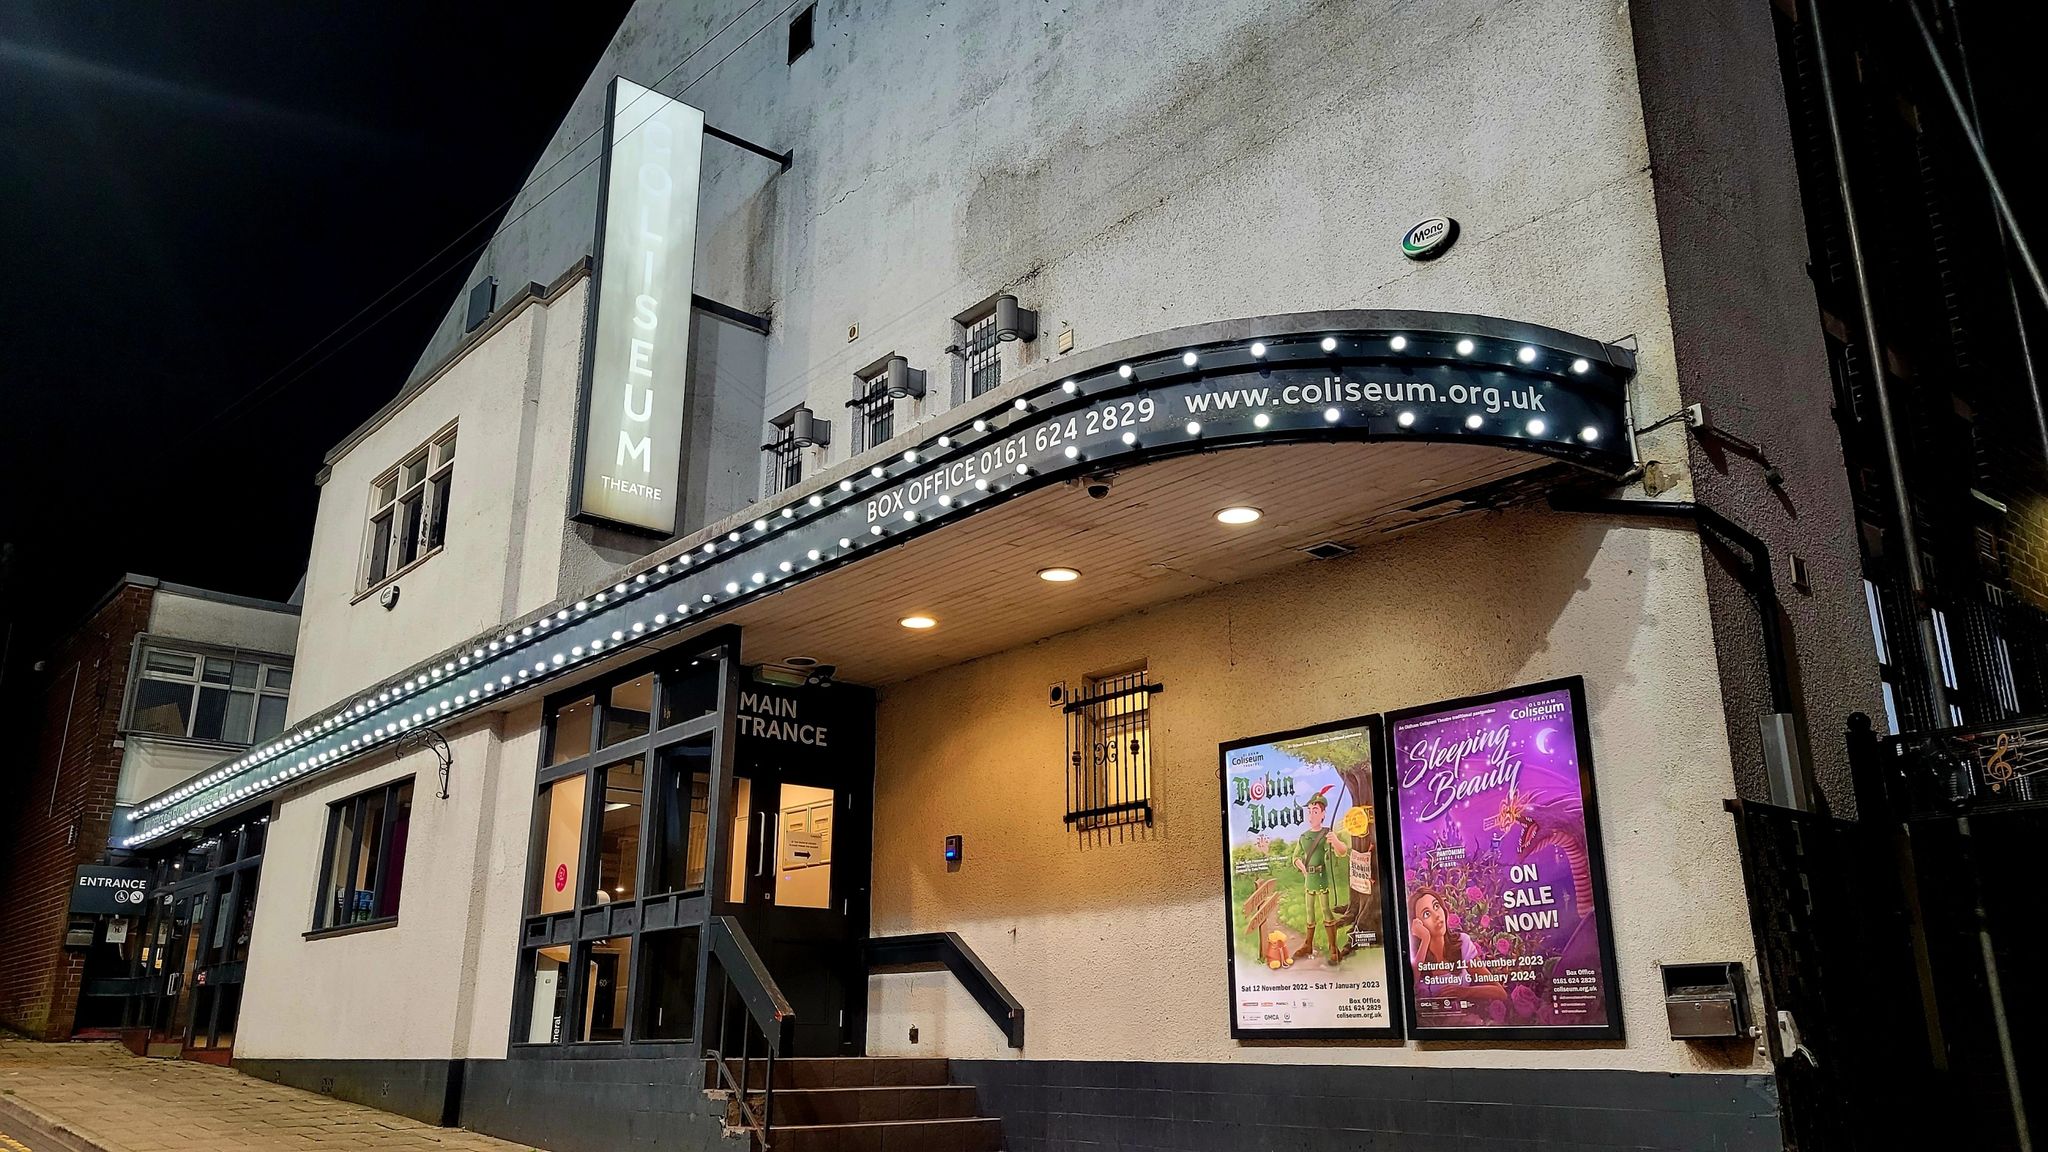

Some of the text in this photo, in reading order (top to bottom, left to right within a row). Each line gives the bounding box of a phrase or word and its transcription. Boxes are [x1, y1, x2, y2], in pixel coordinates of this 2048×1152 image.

[1413, 222, 1444, 245] Mono
[615, 120, 672, 474] COLISEUM
[866, 376, 1546, 523] BOX OFFICE 0161 624 2829 www.coliseum.org.uk
[601, 475, 662, 501] THEATRE
[740, 691, 797, 719] MAIN
[1511, 702, 1565, 720] Coliseum
[1528, 699, 1556, 708] OLDHAM
[1529, 713, 1557, 723] THEATRE
[736, 714, 828, 747] TRANCE
[1231, 754, 1264, 766] Coliseum
[1402, 724, 1511, 789] Sleeping
[1232, 770, 1296, 806] Robin
[1420, 750, 1524, 821] Beauty
[1247, 796, 1304, 834] Hood
[79, 876, 147, 890] ENTRANCE
[1510, 863, 1538, 884] ON
[1503, 885, 1555, 909] SALE
[1504, 909, 1559, 933] NOW!
[1418, 956, 1544, 972] Saturday 11 November 2023
[1578, 968, 1595, 976] Office
[1262, 984, 1291, 992] November
[1315, 982, 1327, 990] Sat
[1328, 982, 1333, 990] 7
[1335, 982, 1360, 990] January
[1424, 974, 1462, 985] Saturday
[1465, 974, 1472, 983] 6
[1474, 972, 1508, 983] January
[1510, 971, 1536, 981] 2024
